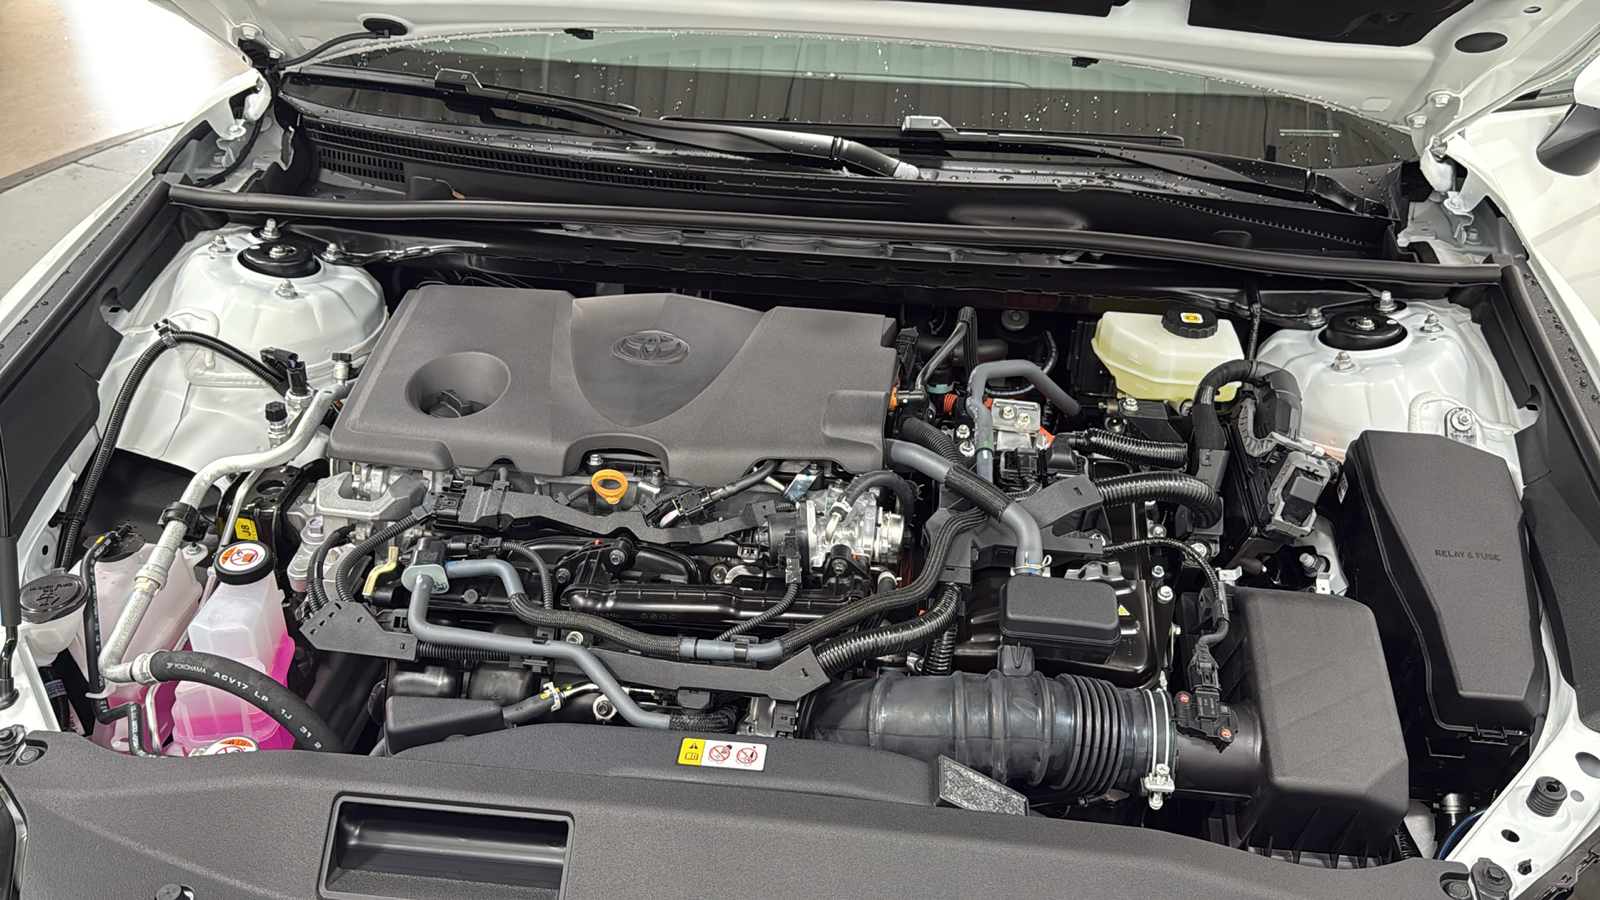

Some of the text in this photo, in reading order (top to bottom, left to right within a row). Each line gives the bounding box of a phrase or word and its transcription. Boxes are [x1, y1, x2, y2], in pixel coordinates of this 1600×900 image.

[1435, 549, 1465, 558] RELAY
[1475, 552, 1501, 561] FUSE
[174, 662, 206, 674] YOKOHAMA
[213, 671, 249, 690] ACV17
[254, 690, 269, 702] LP
